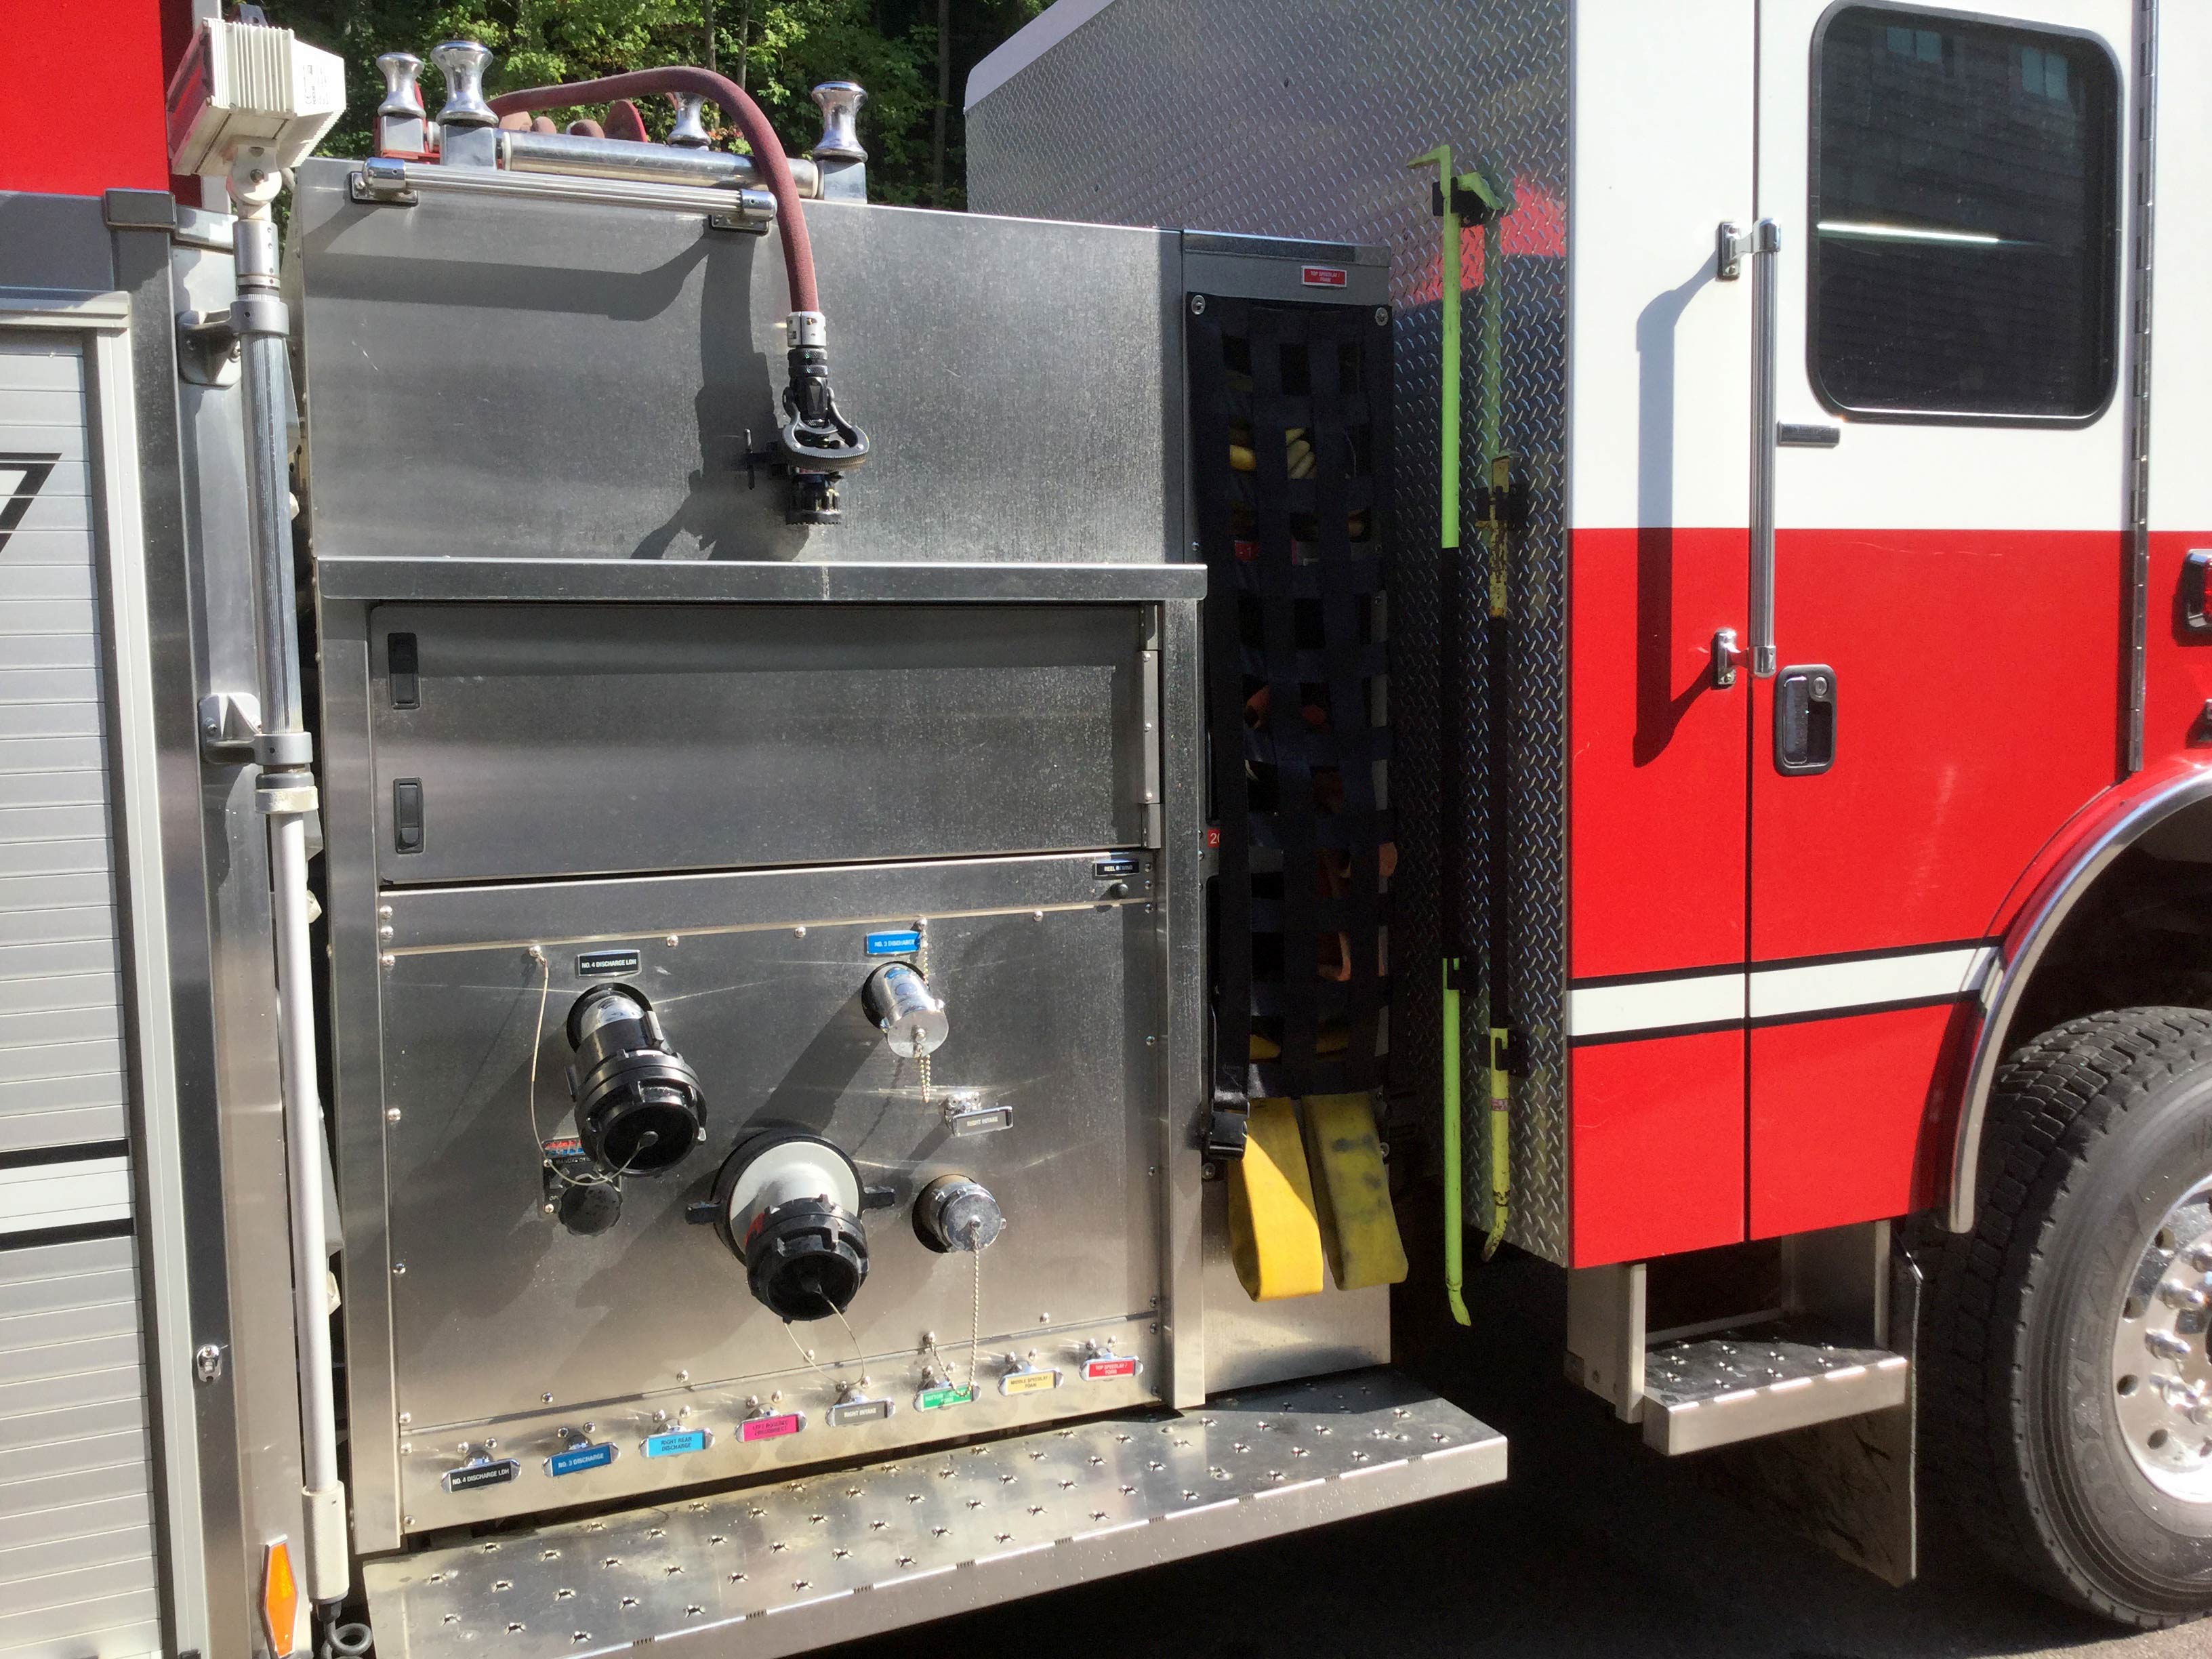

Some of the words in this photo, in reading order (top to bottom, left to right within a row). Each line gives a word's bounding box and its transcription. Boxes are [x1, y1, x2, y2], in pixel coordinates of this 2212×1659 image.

[596, 960, 625, 968] DISCHARGE
[859, 1408, 877, 1416] INTAKE
[661, 1443, 691, 1452] DISCHARGE
[573, 1453, 605, 1465] DISCHARGE
[467, 1470, 498, 1482] DISCHARGE
[498, 1468, 510, 1476] LDH
